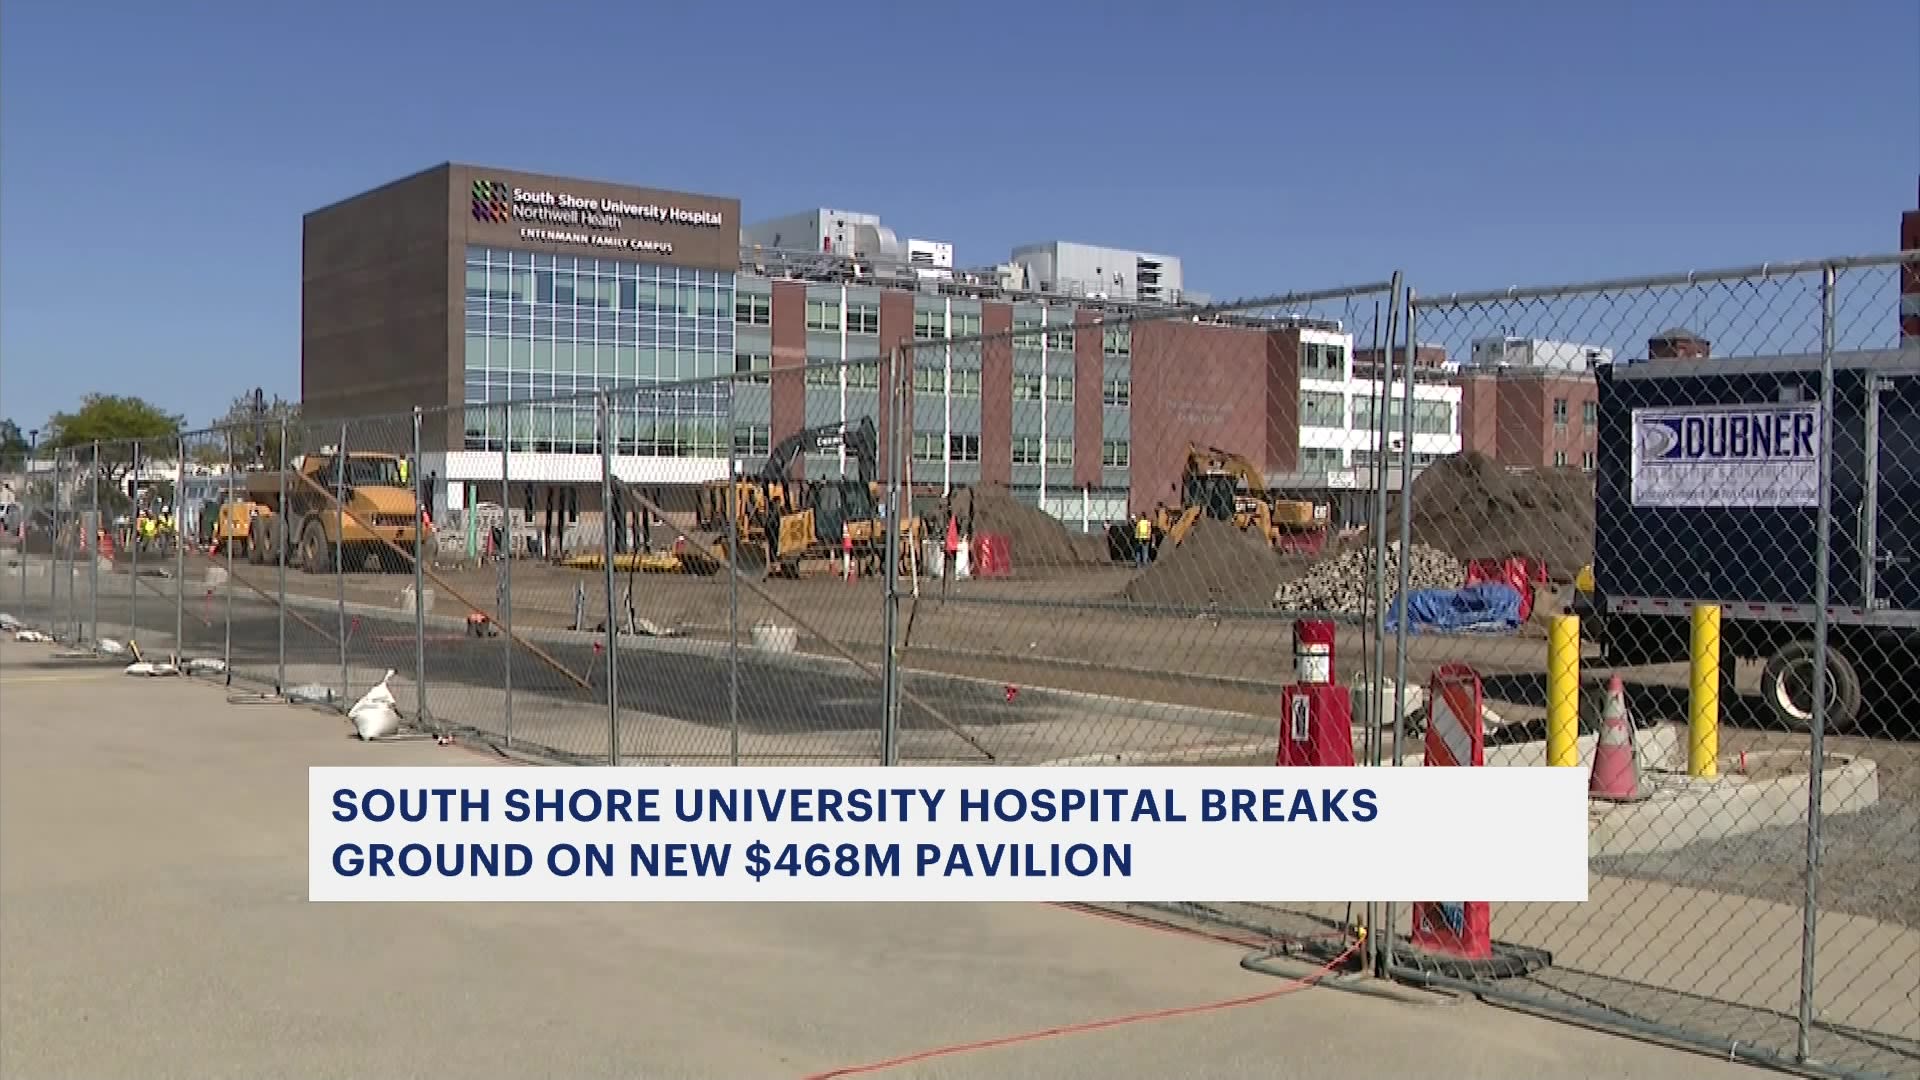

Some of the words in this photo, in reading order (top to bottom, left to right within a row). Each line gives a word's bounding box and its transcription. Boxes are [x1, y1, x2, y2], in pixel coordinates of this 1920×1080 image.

[512, 205, 579, 224] Northwell
[582, 211, 622, 229] Health
[513, 188, 555, 204] South
[558, 194, 598, 210] Shore
[601, 199, 669, 221] University
[670, 207, 722, 227] Hospital
[520, 228, 589, 244] ENTENMANN
[592, 234, 629, 248] FAMILY
[630, 238, 673, 252] CAMPUS
[1686, 413, 1814, 458] DUBNER
